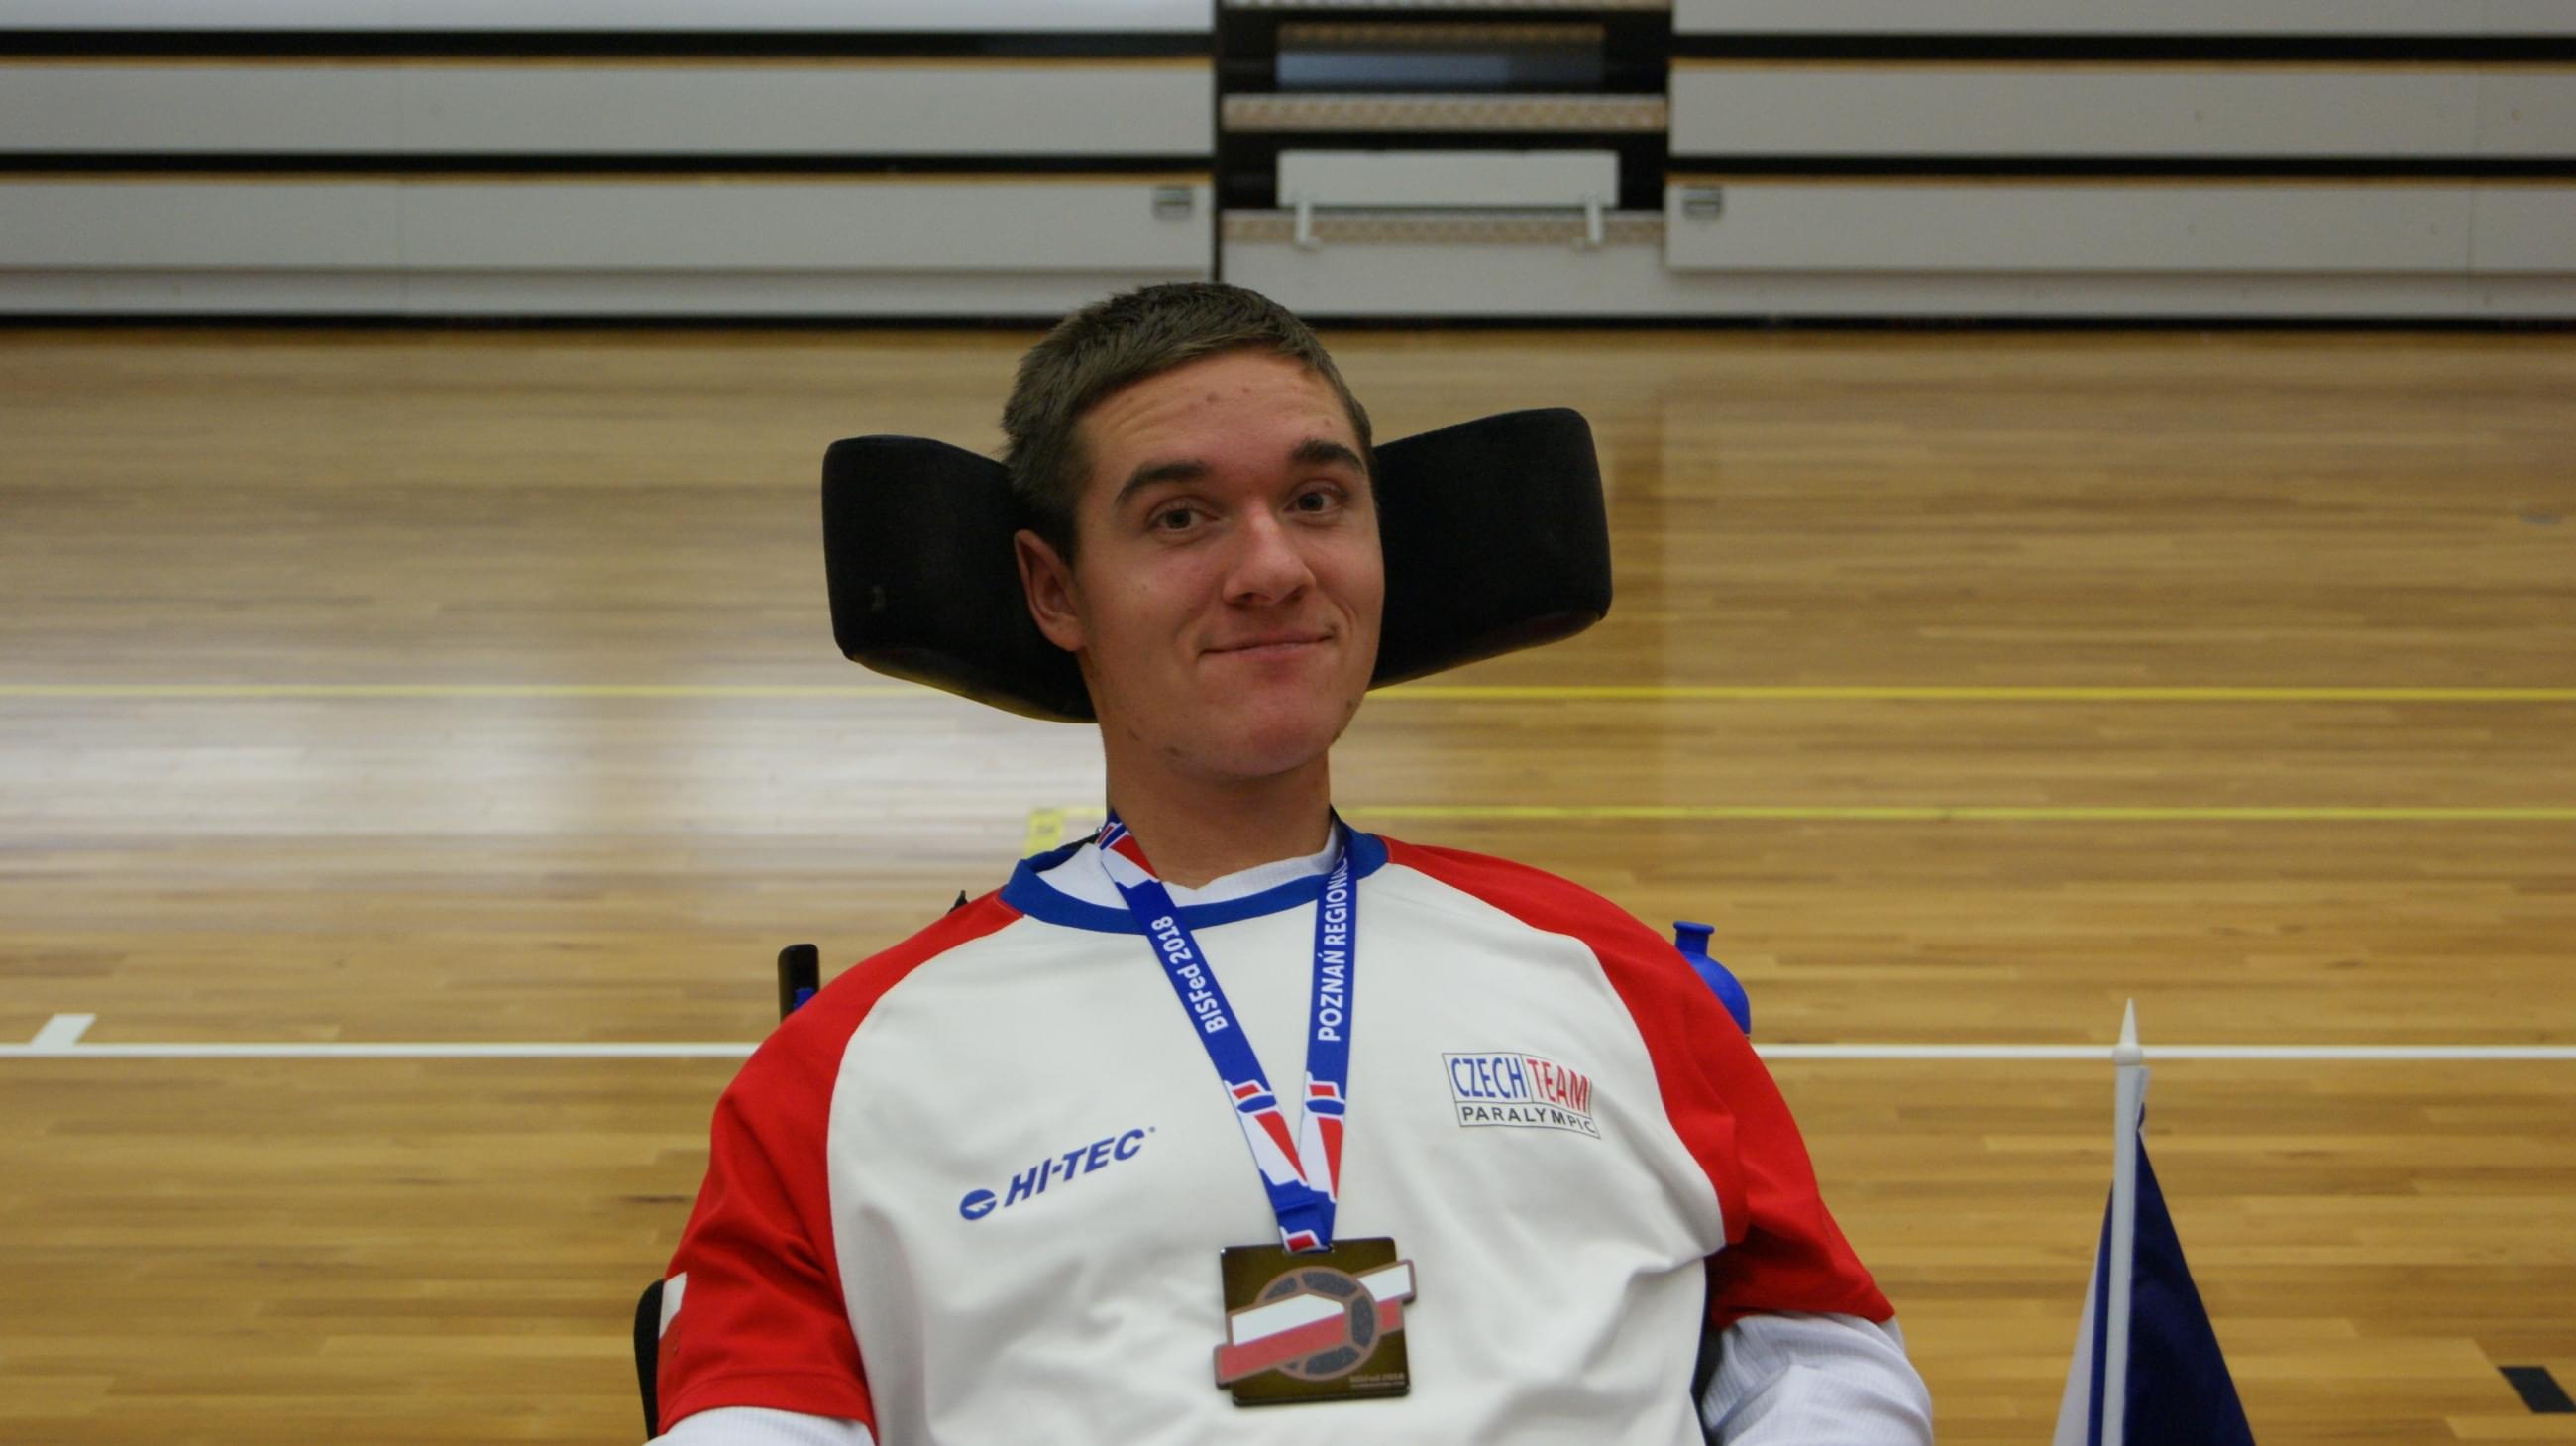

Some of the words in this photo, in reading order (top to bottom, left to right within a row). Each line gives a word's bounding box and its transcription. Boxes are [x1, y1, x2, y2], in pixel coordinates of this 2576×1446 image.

[1151, 916, 1193, 964] 2018
[1176, 963, 1229, 1033] BISFed
[1317, 950, 1345, 1041] POZNAŃ
[1451, 1057, 1527, 1099] CZECH
[1526, 1058, 1589, 1113] TEAM
[1462, 1106, 1596, 1133] PARALYMPIC
[1003, 1128, 1145, 1208] HI-TEC
